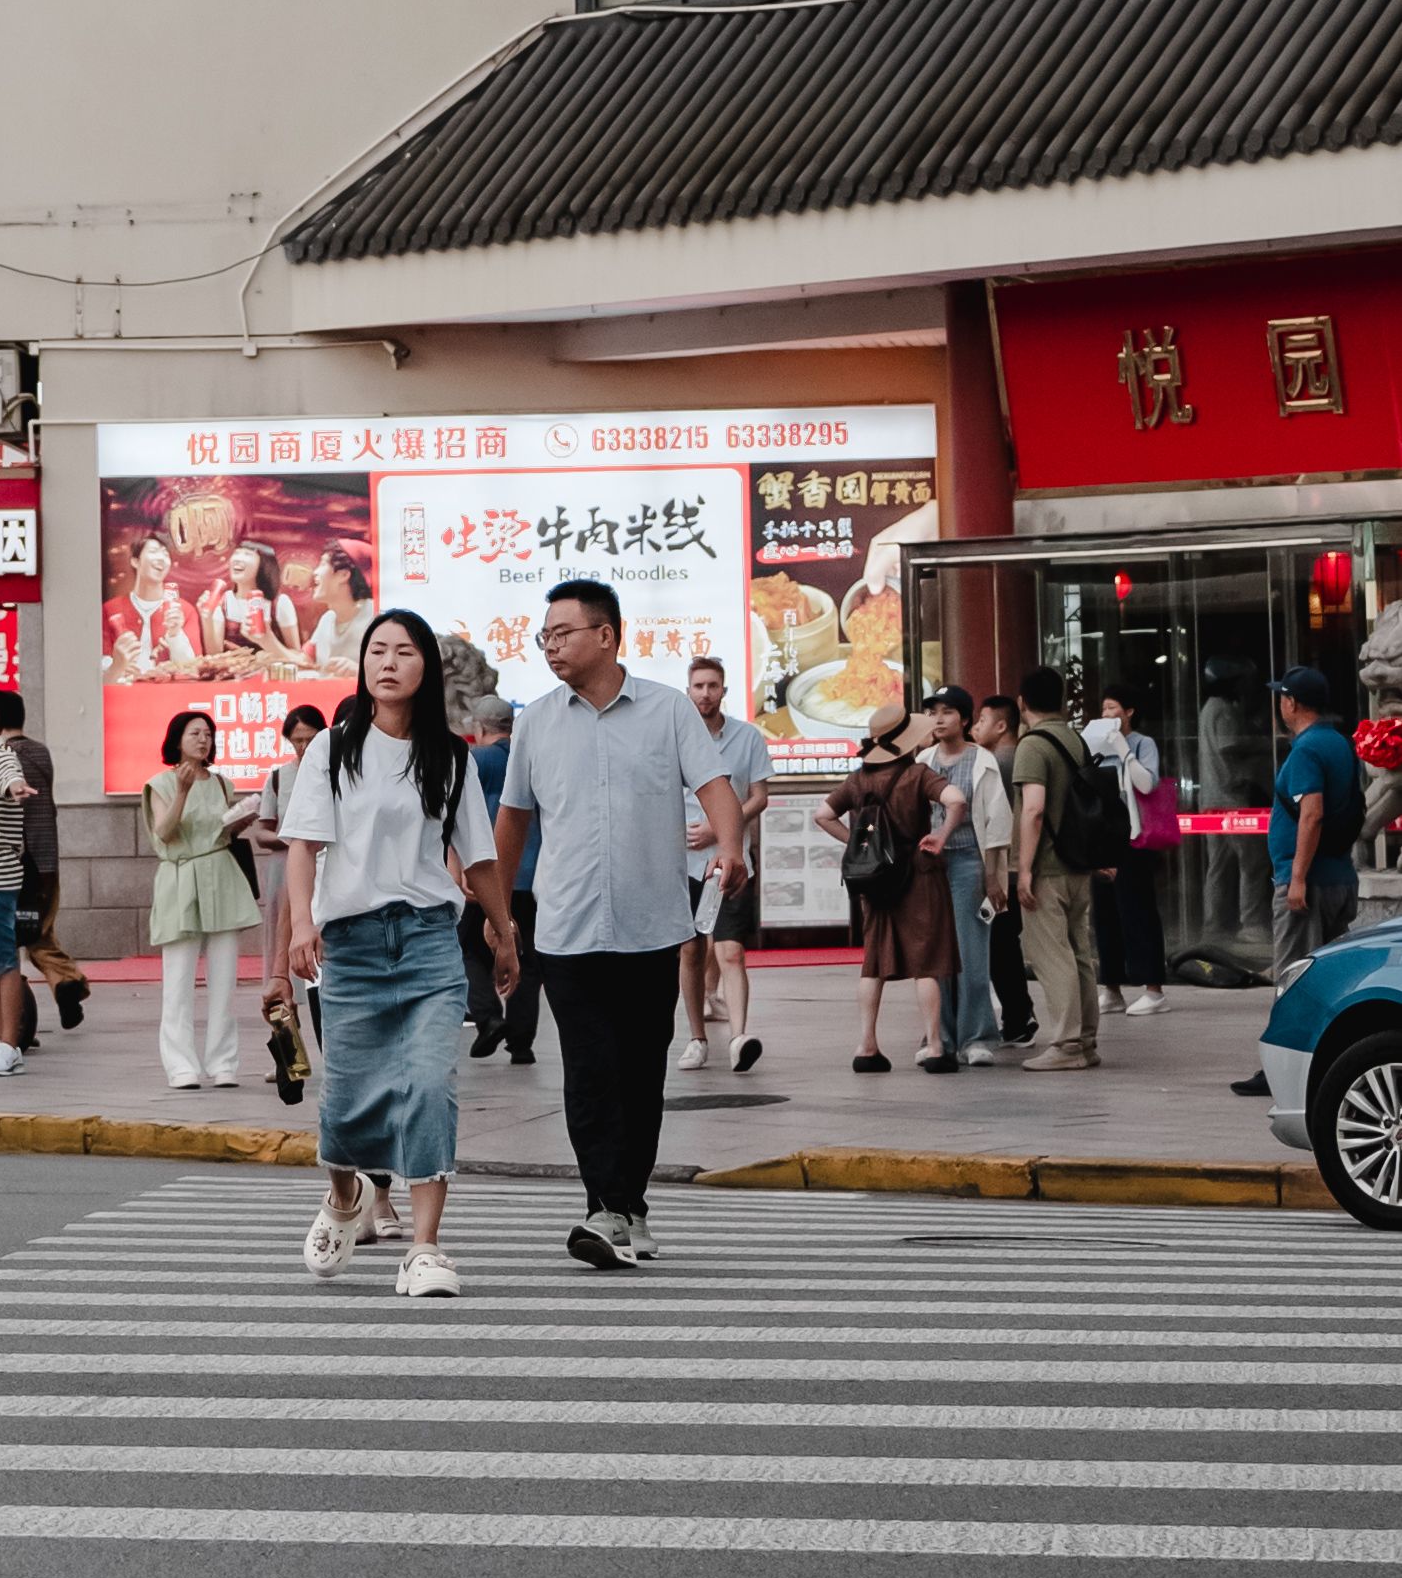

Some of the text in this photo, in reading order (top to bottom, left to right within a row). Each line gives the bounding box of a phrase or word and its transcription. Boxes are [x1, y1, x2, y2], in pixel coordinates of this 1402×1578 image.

[1117, 315, 1344, 431] 悦园
[187, 420, 848, 466] 悦园商厦火爆招商 63338215 63338295
[757, 470, 868, 510] 蟹香园
[441, 494, 717, 563] 生烫牛肉米线
[499, 564, 689, 584] Beef Rice Noodles
[188, 691, 288, 724] 一口畅爽
